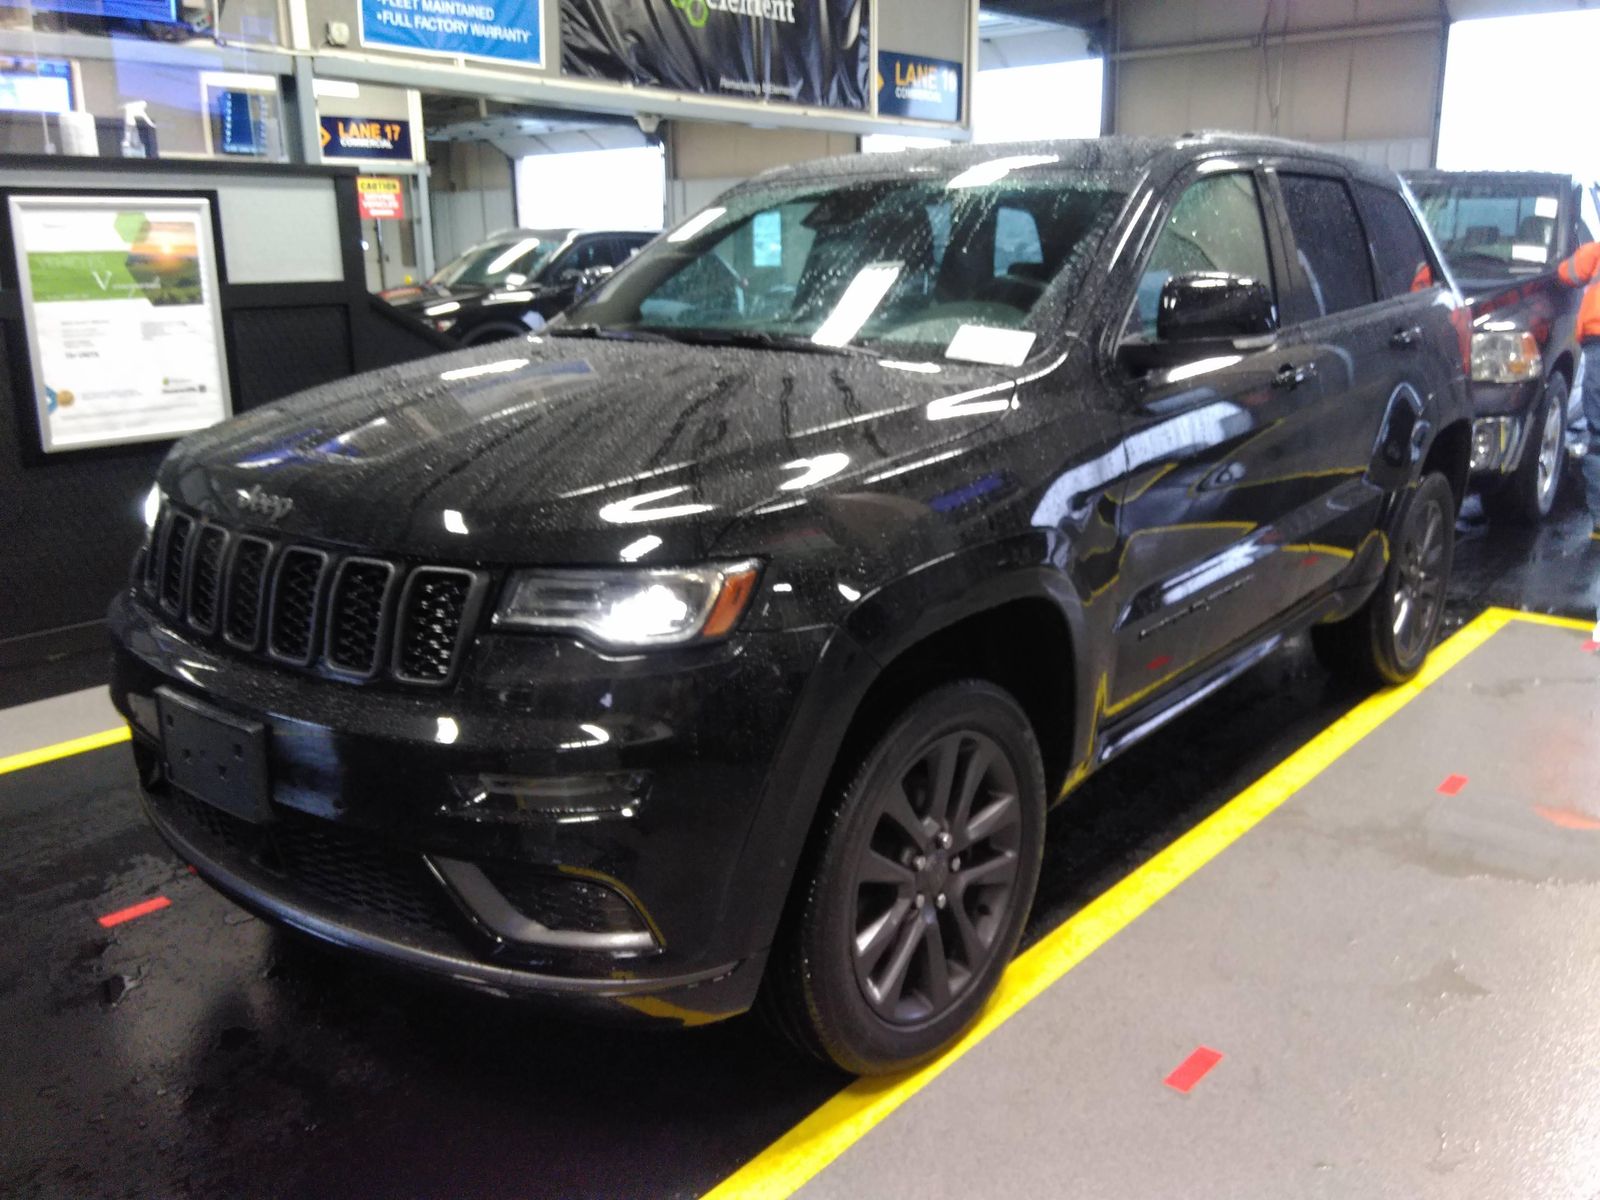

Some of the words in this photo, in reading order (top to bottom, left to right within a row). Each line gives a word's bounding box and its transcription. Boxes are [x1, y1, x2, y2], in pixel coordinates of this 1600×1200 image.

[421, 0, 495, 21] MAINTAINED
[382, 11, 412, 29] FULL
[414, 15, 469, 35] FACTORY
[895, 60, 938, 90] LANE
[337, 121, 381, 141] LANE
[384, 124, 401, 141] 17
